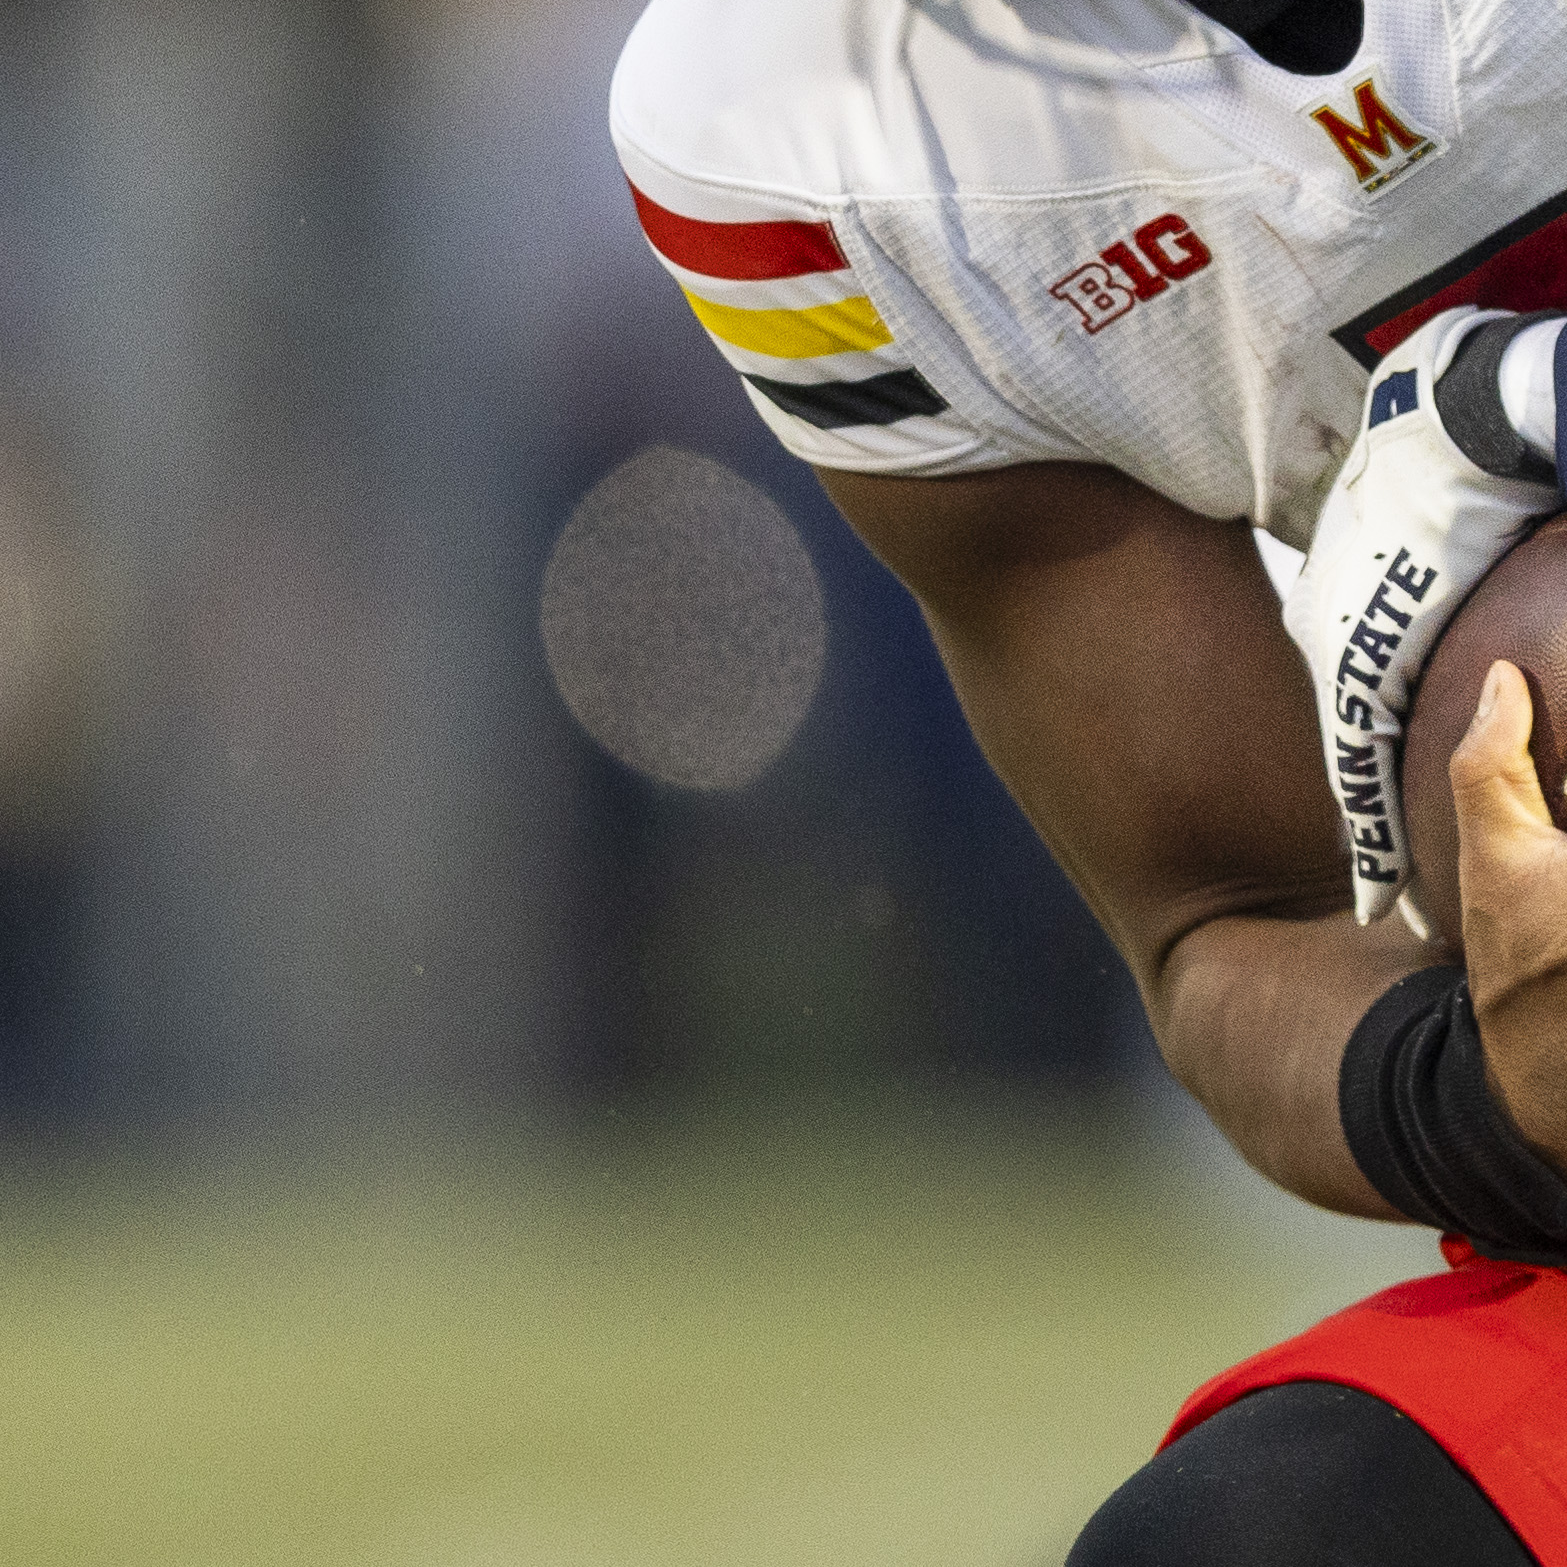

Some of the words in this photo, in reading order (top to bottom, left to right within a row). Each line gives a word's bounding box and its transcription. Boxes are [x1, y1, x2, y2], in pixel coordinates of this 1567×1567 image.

[1308, 77, 1429, 184] M
[1335, 546, 1439, 732] STATE
[1335, 732, 1400, 884] PENN
